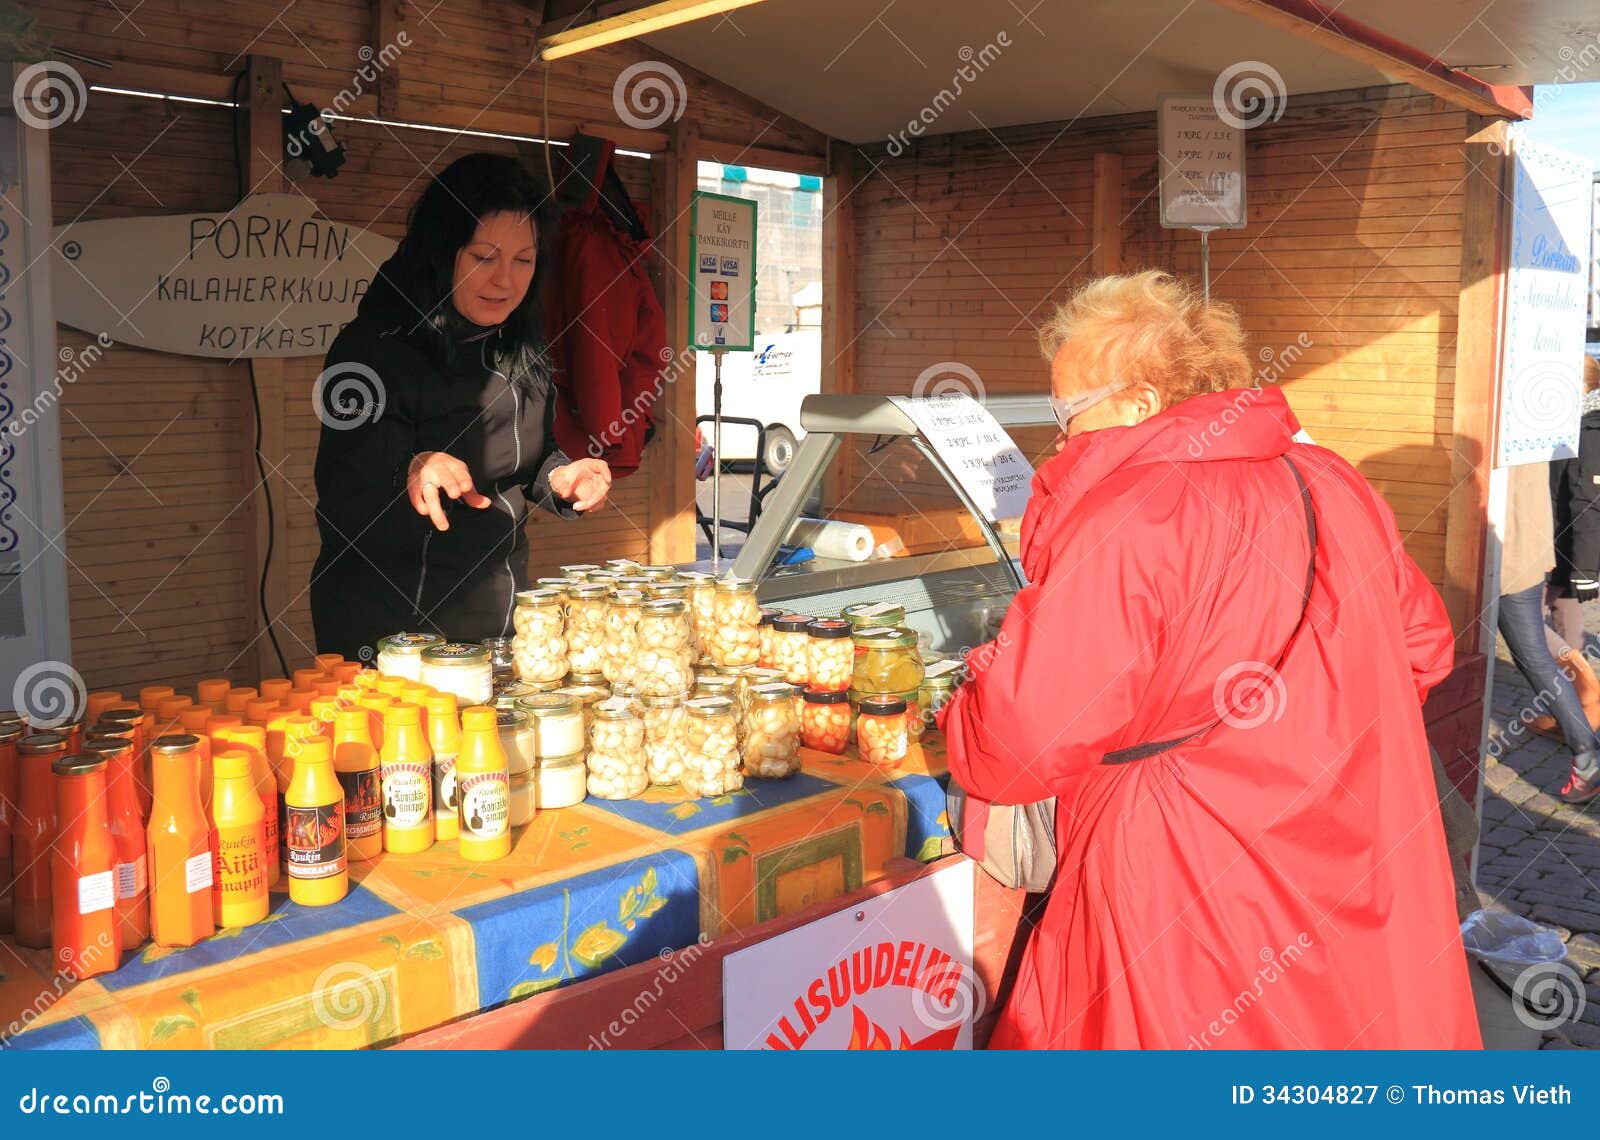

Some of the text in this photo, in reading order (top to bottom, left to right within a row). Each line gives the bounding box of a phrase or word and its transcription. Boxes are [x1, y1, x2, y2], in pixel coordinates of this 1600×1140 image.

[712, 209, 737, 222] MEILLE
[716, 222, 731, 234] KÄY
[189, 215, 348, 261] PORKAN
[697, 233, 749, 250] PANKKIKORTTI
[702, 256, 738, 270] VISA VISA
[157, 275, 369, 303] KALAHERKKUJA
[200, 322, 351, 350] KOTKAST
[289, 851, 321, 863] Ruukin
[760, 941, 964, 1050] ILISUUDELMA
